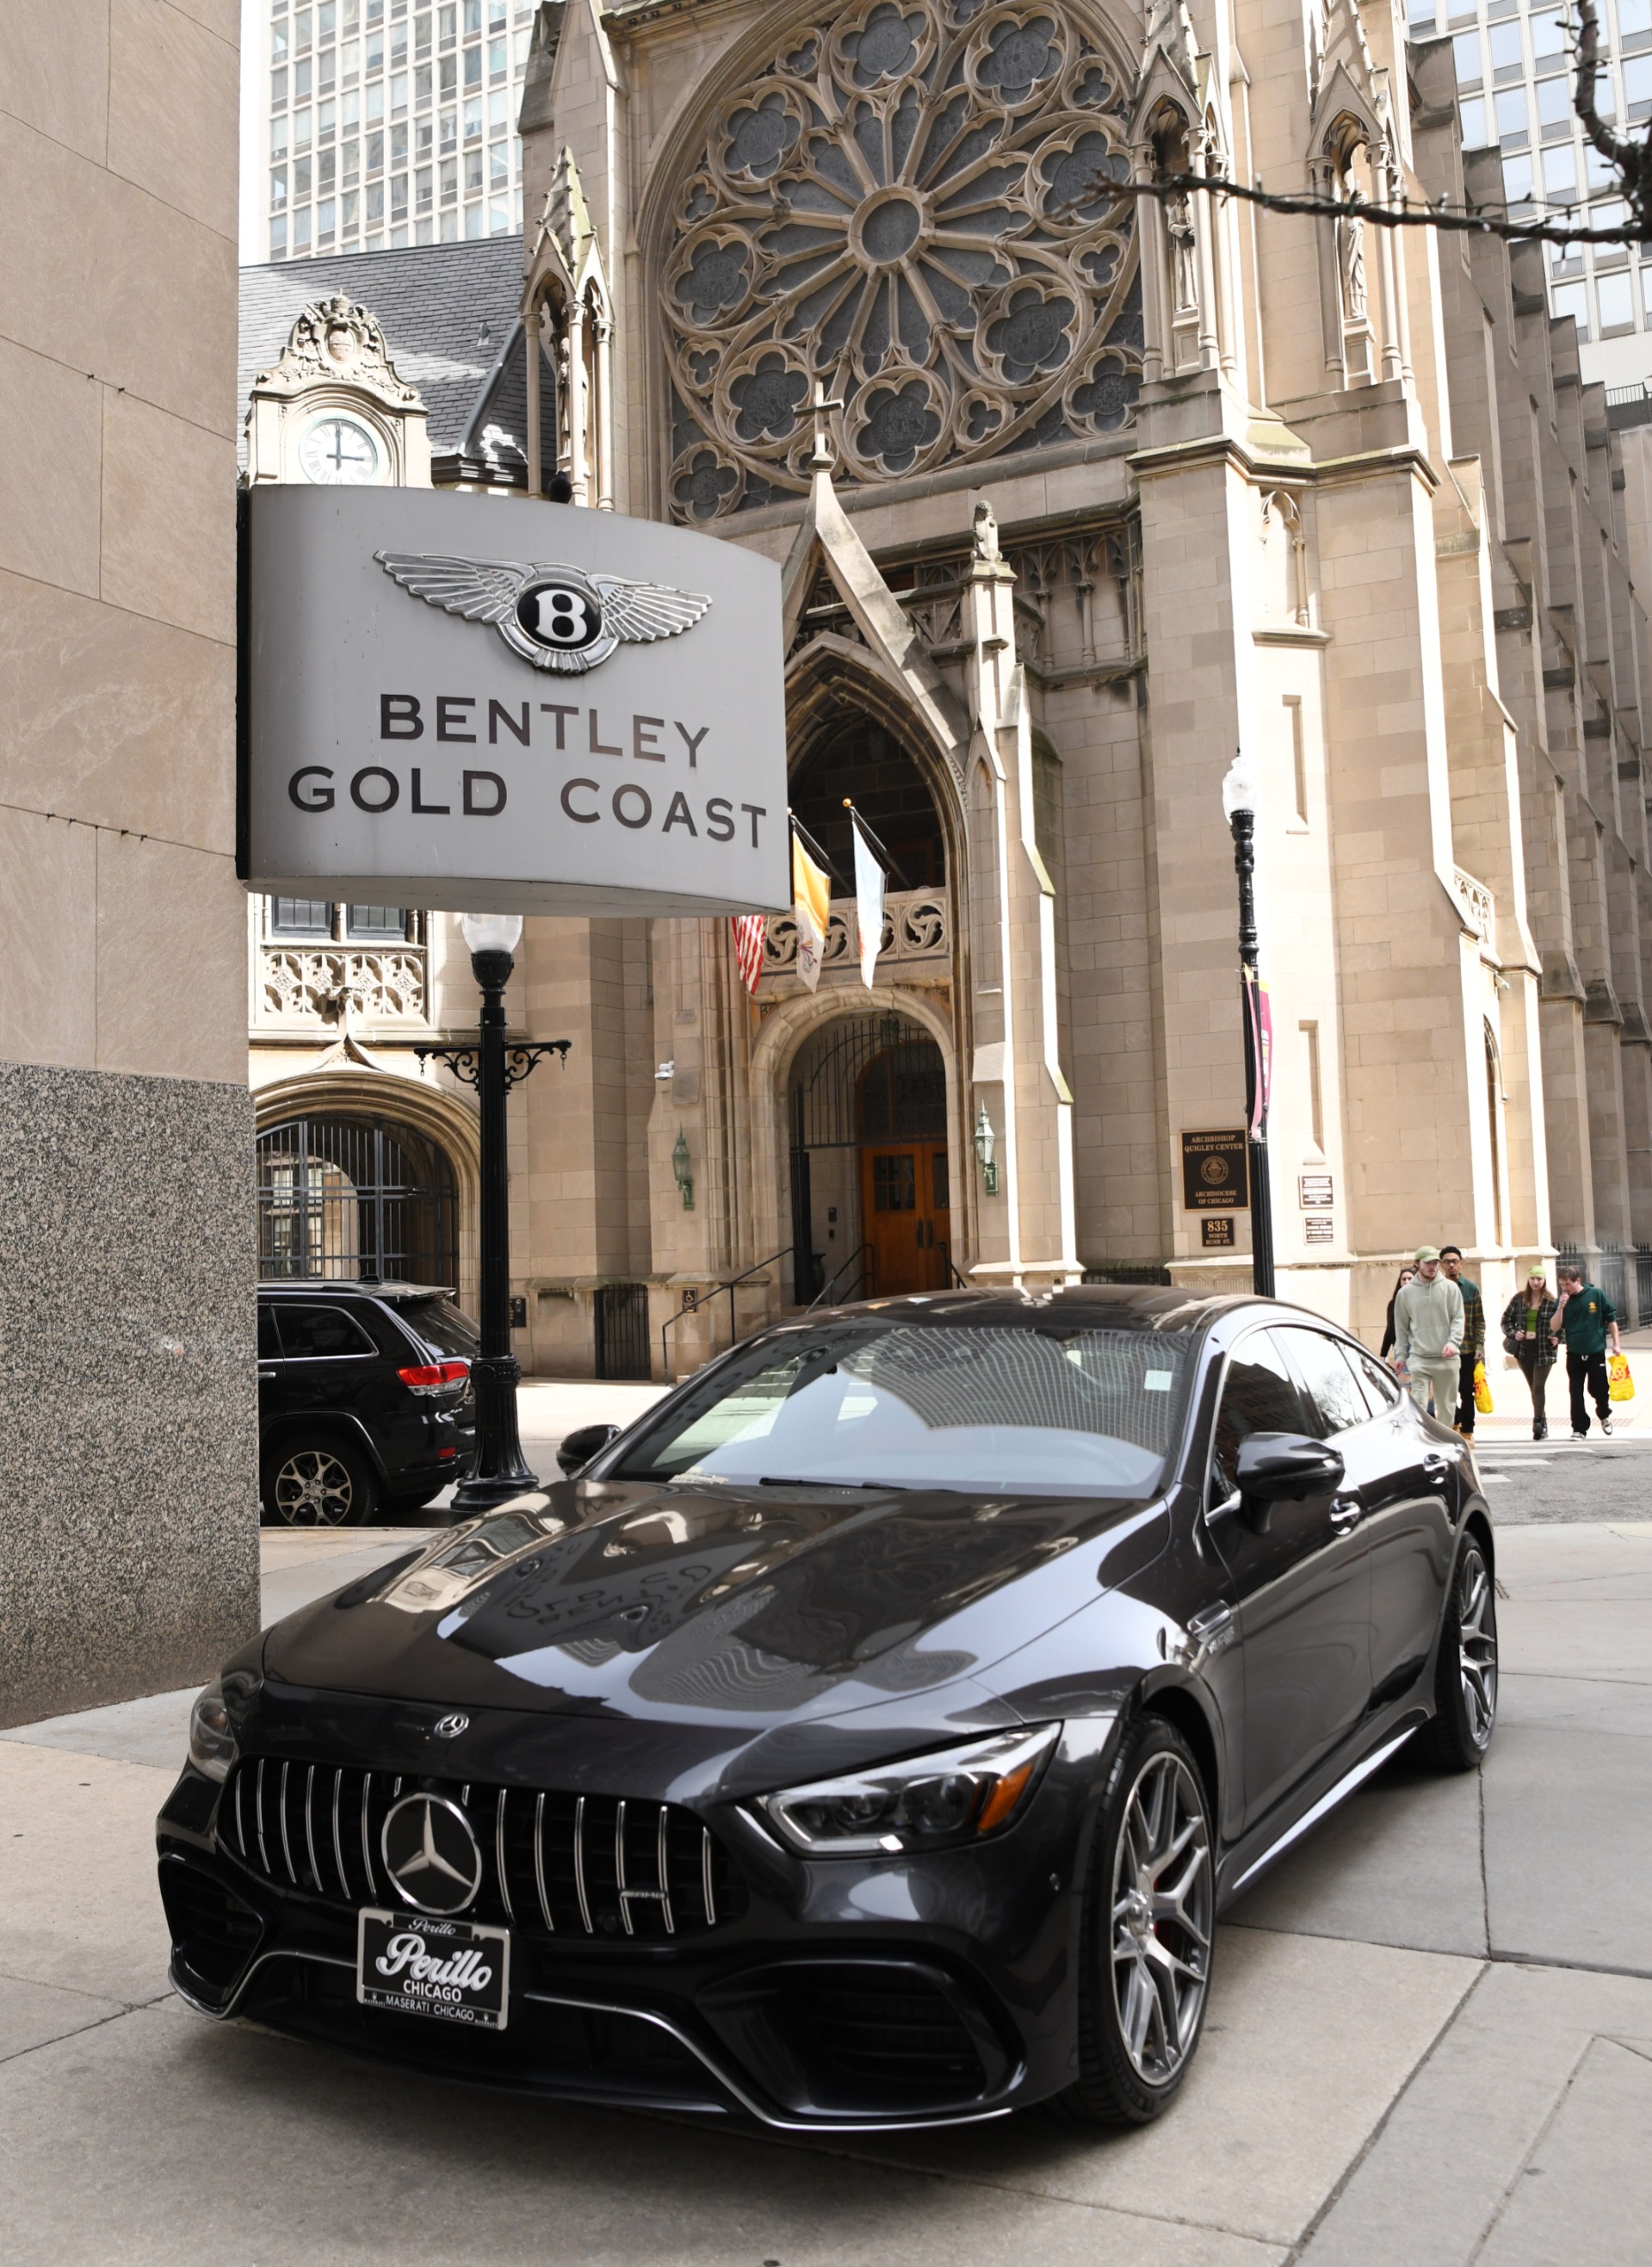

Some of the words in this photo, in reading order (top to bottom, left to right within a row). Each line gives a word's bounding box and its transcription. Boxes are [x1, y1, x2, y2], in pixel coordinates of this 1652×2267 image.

[534, 588, 589, 644] B
[380, 693, 711, 769] BENTLEY
[288, 765, 508, 816] GOLD
[560, 777, 767, 849] COAST
[1184, 1144, 1215, 1153] QUIGLEY
[1191, 1135, 1236, 1143] ARCHBISHOP
[1207, 1220, 1228, 1232] 835
[408, 1918, 456, 1935] Perillo
[375, 1933, 492, 1991] Perillo
[403, 1979, 462, 2003] CHICAGO
[386, 1994, 430, 2012] MASERATI
[433, 2005, 474, 2021] CHICAGO
